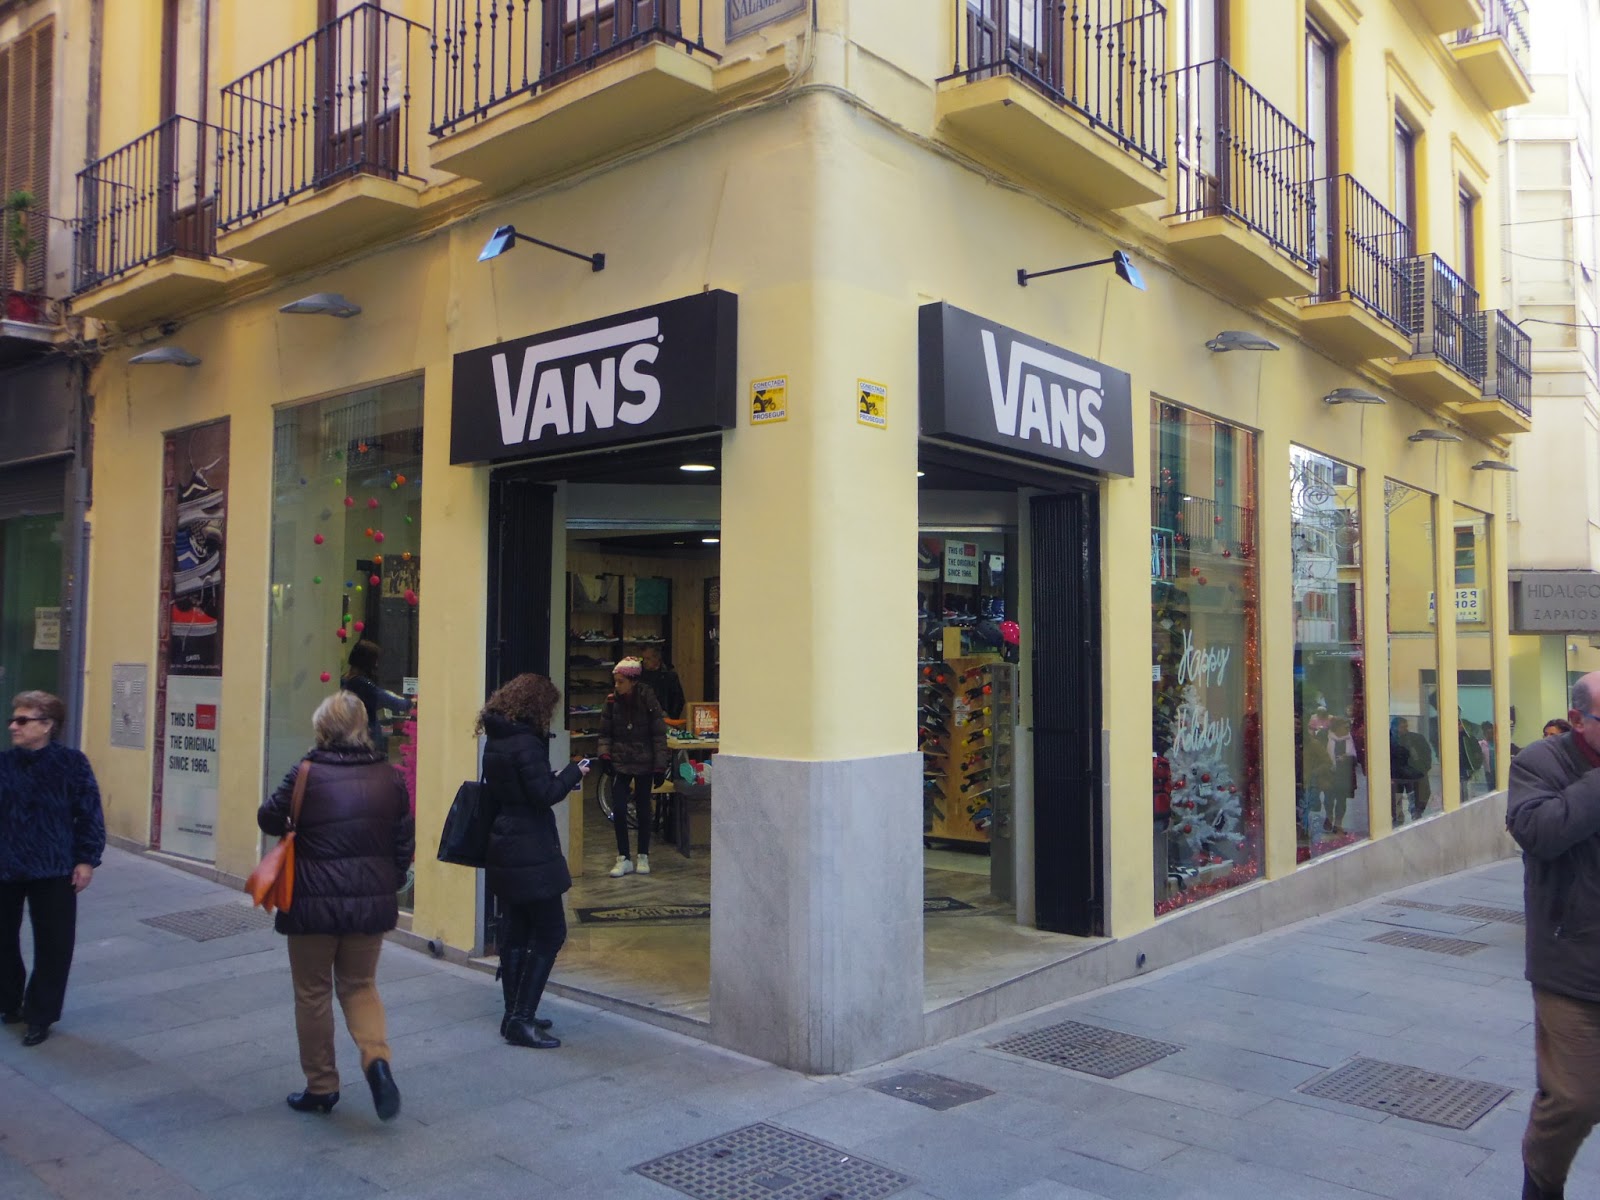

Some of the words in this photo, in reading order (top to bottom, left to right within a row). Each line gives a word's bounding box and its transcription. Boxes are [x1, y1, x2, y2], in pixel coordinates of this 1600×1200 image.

[491, 316, 664, 446] VANS
[753, 379, 785, 389] CONECTADA
[980, 329, 1106, 458] VANS
[752, 410, 785, 420] PROSEGUR
[859, 413, 885, 425] PROSEGUR
[1527, 584, 1600, 599] HIDALGO
[1533, 609, 1598, 620] ZAPATOS
[171, 712, 186, 727] THIS
[187, 712, 194, 728] IS
[170, 735, 183, 749] THE
[184, 736, 216, 752] ORIGINAL
[169, 755, 189, 771] SINCE
